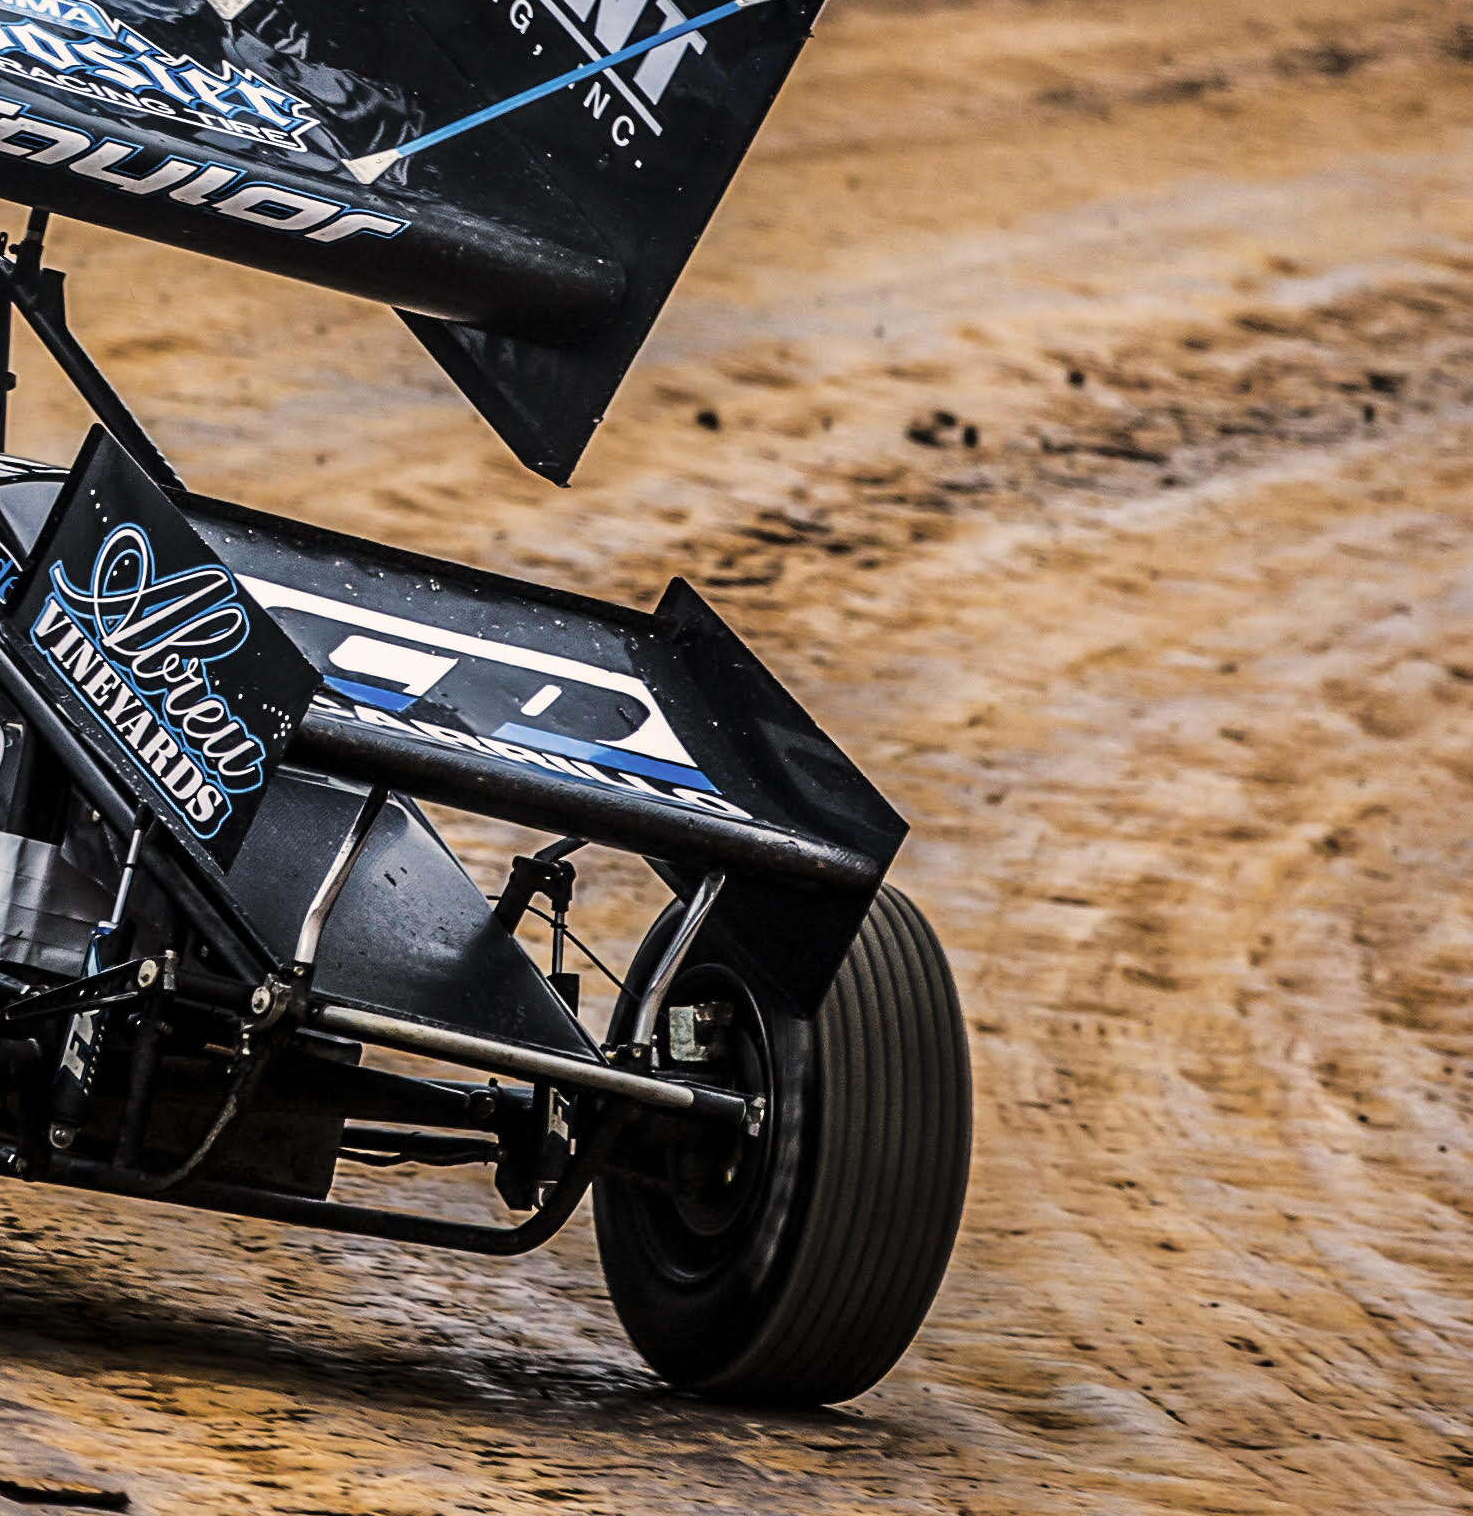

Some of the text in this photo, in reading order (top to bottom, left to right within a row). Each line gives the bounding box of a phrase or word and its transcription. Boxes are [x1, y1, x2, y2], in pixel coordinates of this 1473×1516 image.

[185, 104, 298, 148] TIRE
[567, 62, 643, 169] NC.
[33, 599, 224, 823] VINEYARDS
[54, 527, 258, 777] Abreu
